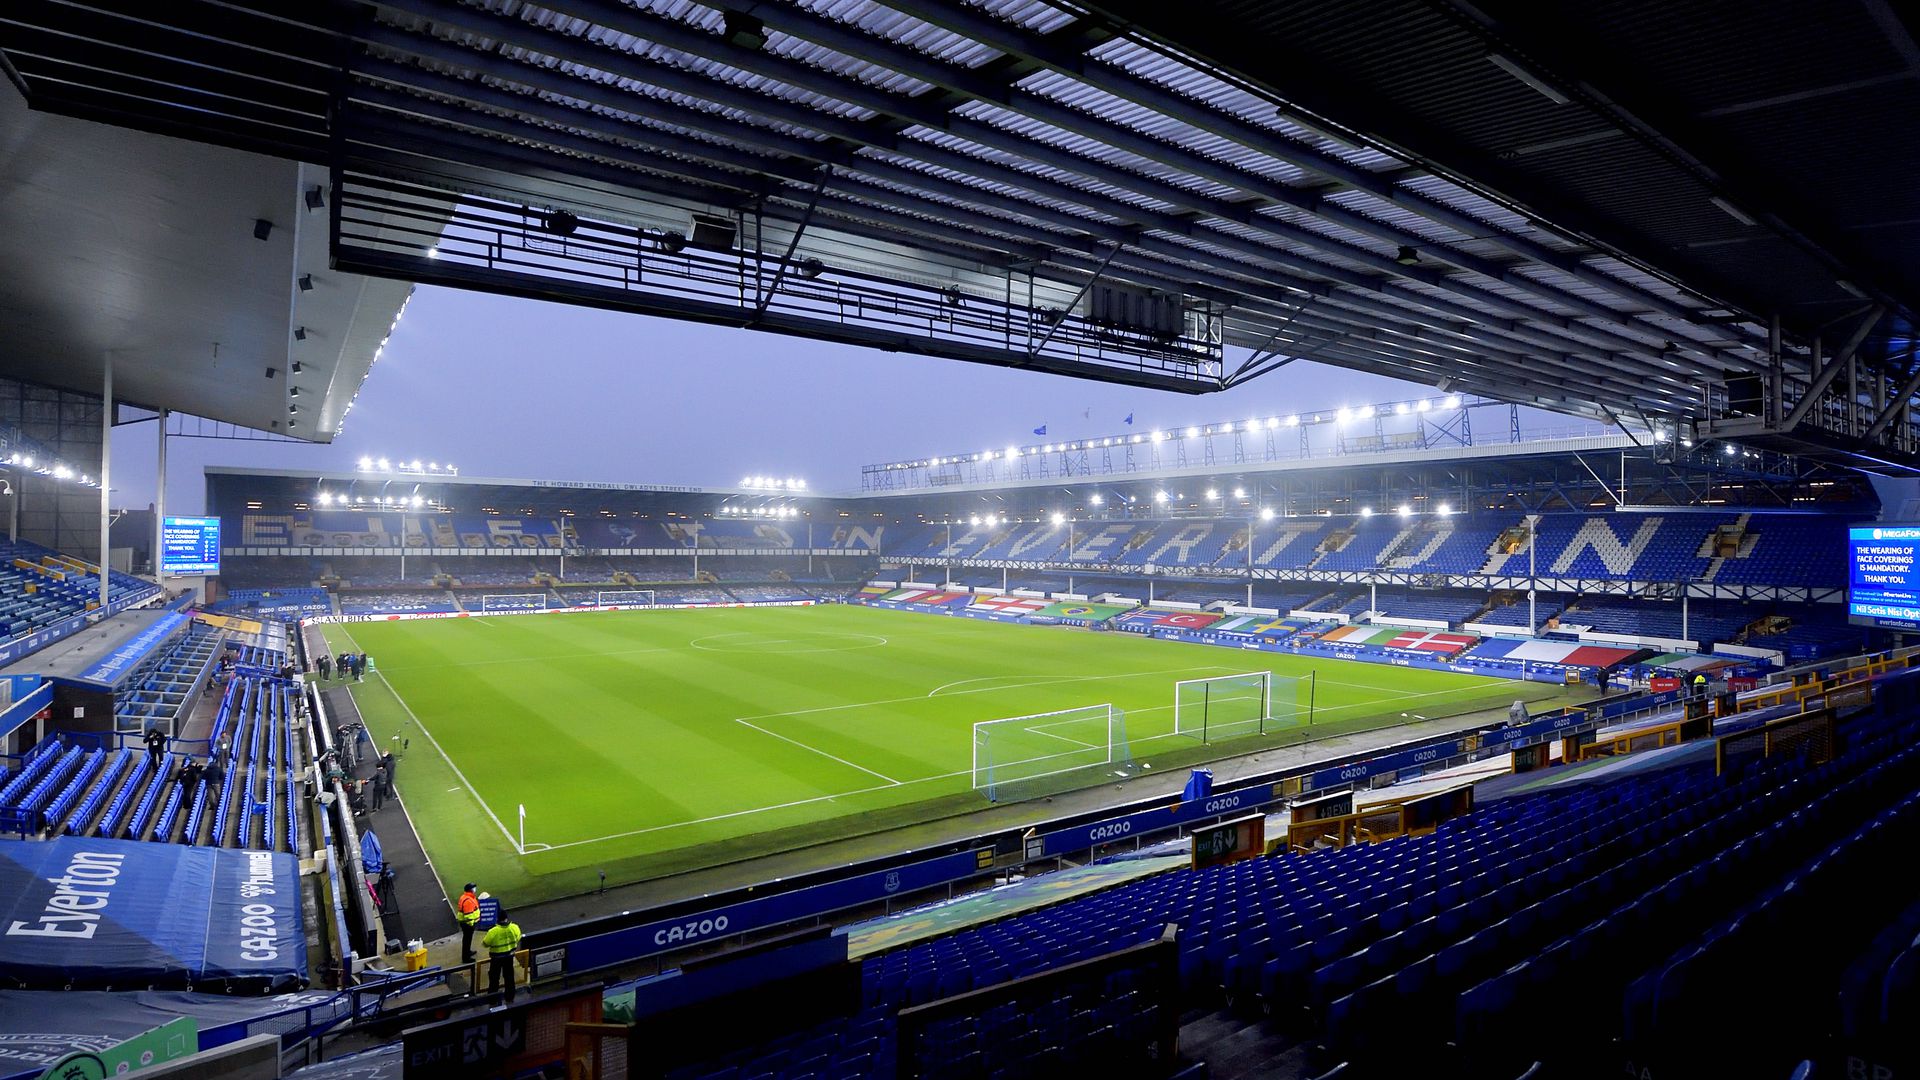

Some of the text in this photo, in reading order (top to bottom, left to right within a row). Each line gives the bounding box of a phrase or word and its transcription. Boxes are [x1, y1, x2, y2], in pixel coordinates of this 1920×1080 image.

[312, 614, 372, 625] SALAMI BITES
[1323, 641, 1366, 649] CAZOO
[1532, 662, 1591, 672] CAZOO
[1503, 729, 1522, 740] CAZOO
[1414, 750, 1437, 762] CAZOO
[1340, 766, 1367, 780] CAZOO
[1205, 796, 1240, 813] CAZOO
[1090, 821, 1131, 840] CAZOO
[5, 852, 125, 939] Everton
[241, 903, 278, 961] CAZOO
[654, 915, 729, 946] CAZOO
[411, 1042, 455, 1067] EXIT
